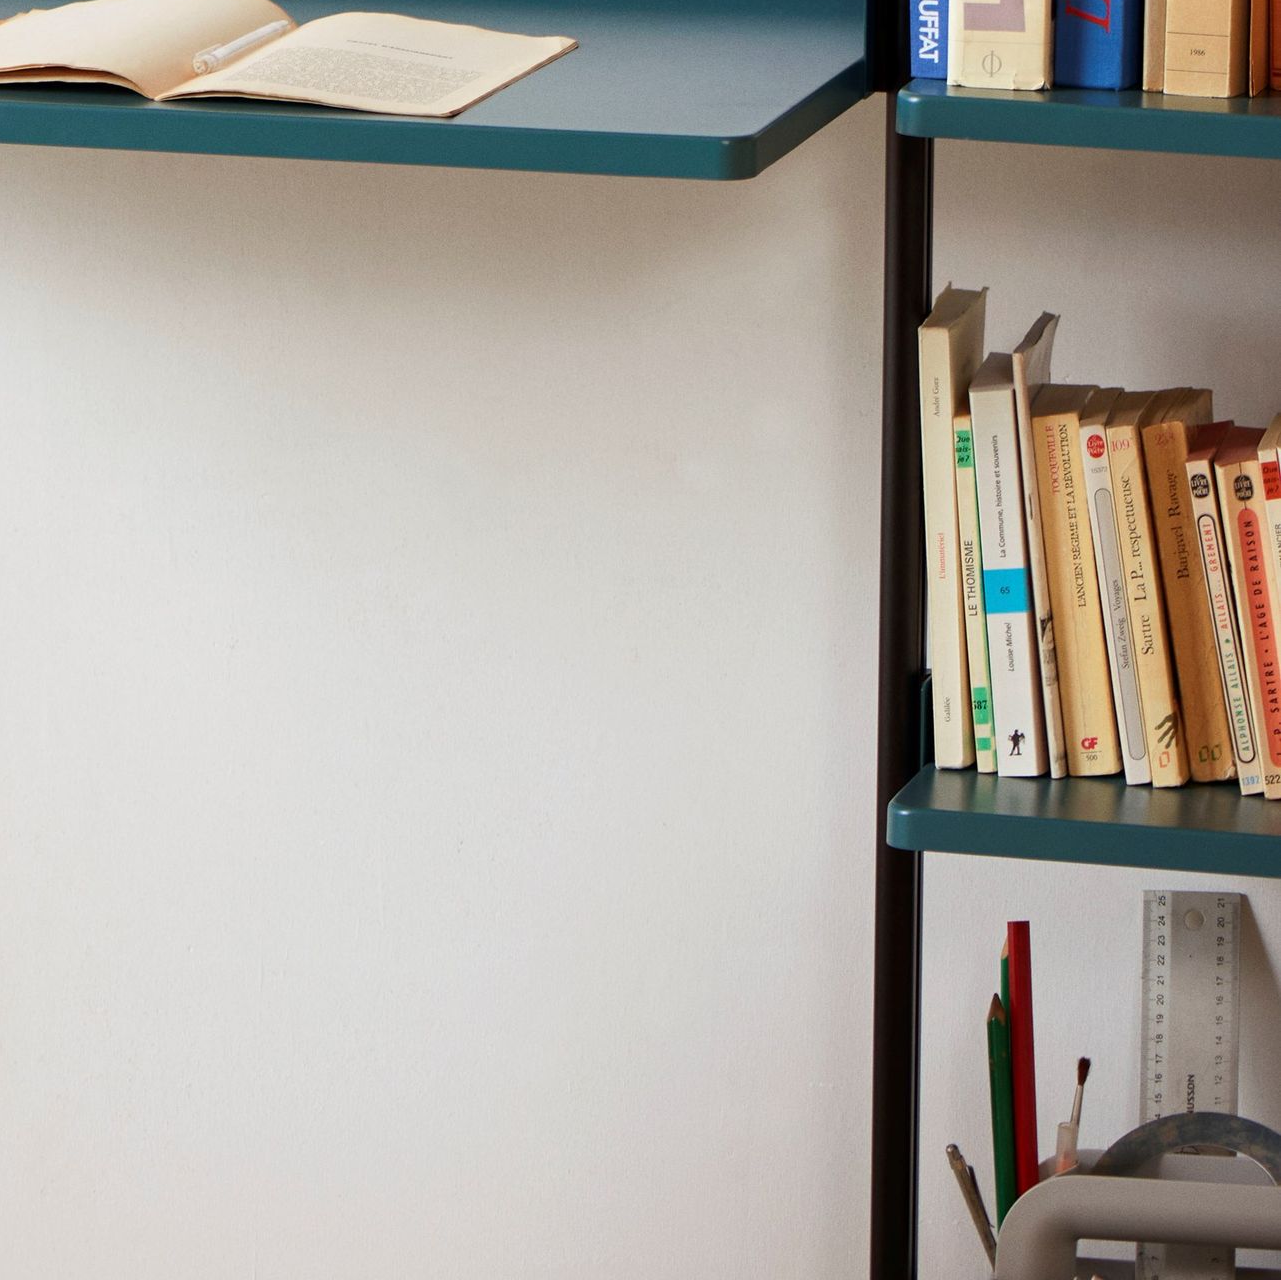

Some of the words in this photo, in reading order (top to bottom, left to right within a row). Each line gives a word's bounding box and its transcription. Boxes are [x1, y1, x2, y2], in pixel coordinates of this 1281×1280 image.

[1190, 48, 1206, 57] 1986
[992, 434, 1000, 468] souvenirs
[1111, 438, 1130, 453] 109
[1044, 424, 1061, 496] TOCQUEVILLE
[1058, 423, 1075, 489] RÉVOLUTION
[994, 468, 1001, 478] et
[994, 477, 1002, 507] histoire
[1065, 491, 1076, 505] LA
[1166, 469, 1182, 517] Ravage
[1066, 507, 1077, 520] ET
[1120, 475, 1143, 558] respectueuse
[997, 508, 1006, 549] Commune,
[999, 549, 1007, 558] La
[1202, 522, 1219, 573] GREMENT
[1243, 520, 1260, 573] RAISON
[963, 540, 976, 600] THOMISME
[999, 586, 1011, 595] 65
[1072, 562, 1087, 608] L'ANCIEN
[1134, 583, 1147, 602] La
[1252, 579, 1263, 596] DE
[968, 604, 978, 617] LE
[1255, 603, 1270, 641] L'AGE
[1004, 622, 1014, 647] Michel
[1141, 614, 1155, 655] Sartre
[1007, 648, 1015, 672] Louise
[1119, 643, 1130, 669] Stefan
[1225, 652, 1240, 689] ALLAIS
[1263, 661, 1281, 714] SARTRE
[1232, 697, 1251, 752] ALPHONSE
[1158, 895, 1166, 906] 25
[1158, 915, 1166, 926] 24
[1158, 935, 1166, 946] 23
[1157, 954, 1165, 966] 22
[1157, 975, 1165, 985] 21
[1156, 994, 1164, 1005] 20
[1156, 1014, 1164, 1024] 19
[1155, 1033, 1163, 1044] 18
[1155, 1054, 1163, 1064] 17
[1155, 1073, 1163, 1083] 16
[1155, 1093, 1162, 1104] 15
